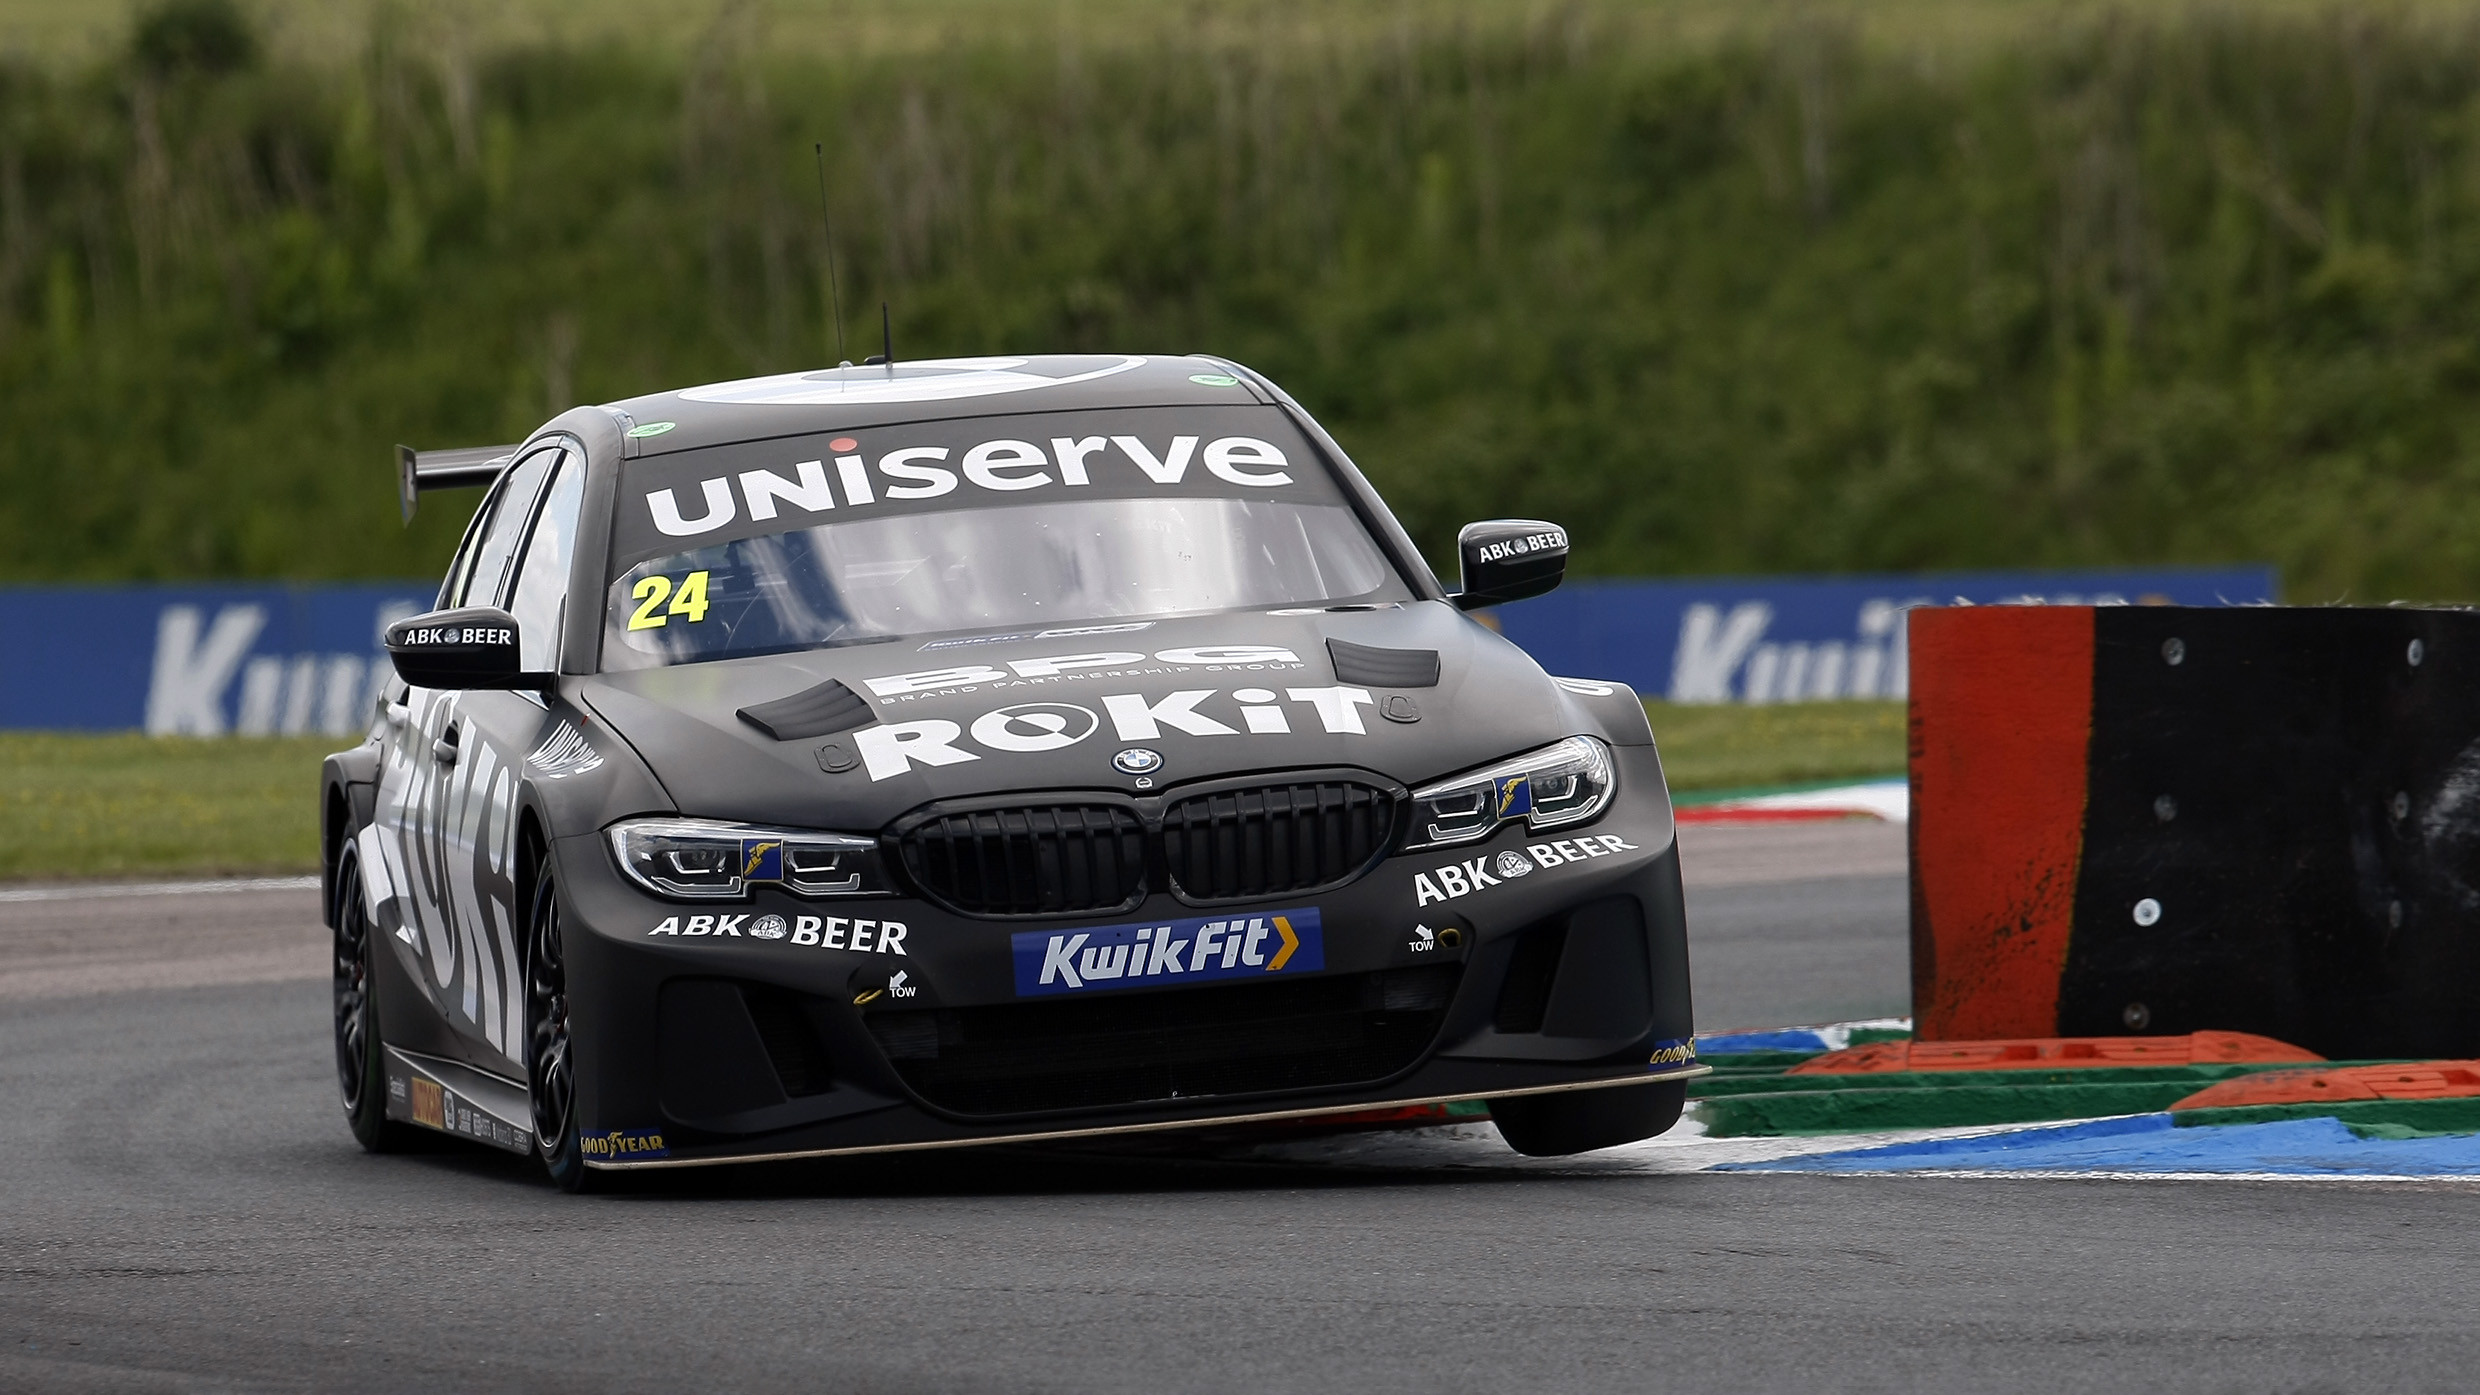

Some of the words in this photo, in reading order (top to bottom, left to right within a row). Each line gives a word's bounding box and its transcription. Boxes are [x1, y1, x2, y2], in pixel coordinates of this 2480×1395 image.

[1480, 541, 1515, 563] ABK
[1527, 533, 1565, 551] BEER
[627, 570, 710, 628] 24
[404, 628, 443, 645] ABK
[462, 628, 512, 645] BEER
[863, 645, 1300, 698] BPG
[880, 685, 979, 705] BRAND
[993, 665, 1191, 689] PARTNERSHIP
[1204, 663, 1305, 673] GROUP
[1414, 855, 1502, 907] ABK
[1526, 835, 1638, 869] BEER
[648, 914, 751, 937] ABK
[790, 915, 909, 955] BEER
[1409, 940, 1434, 952] TOW
[890, 987, 916, 998] TOW
